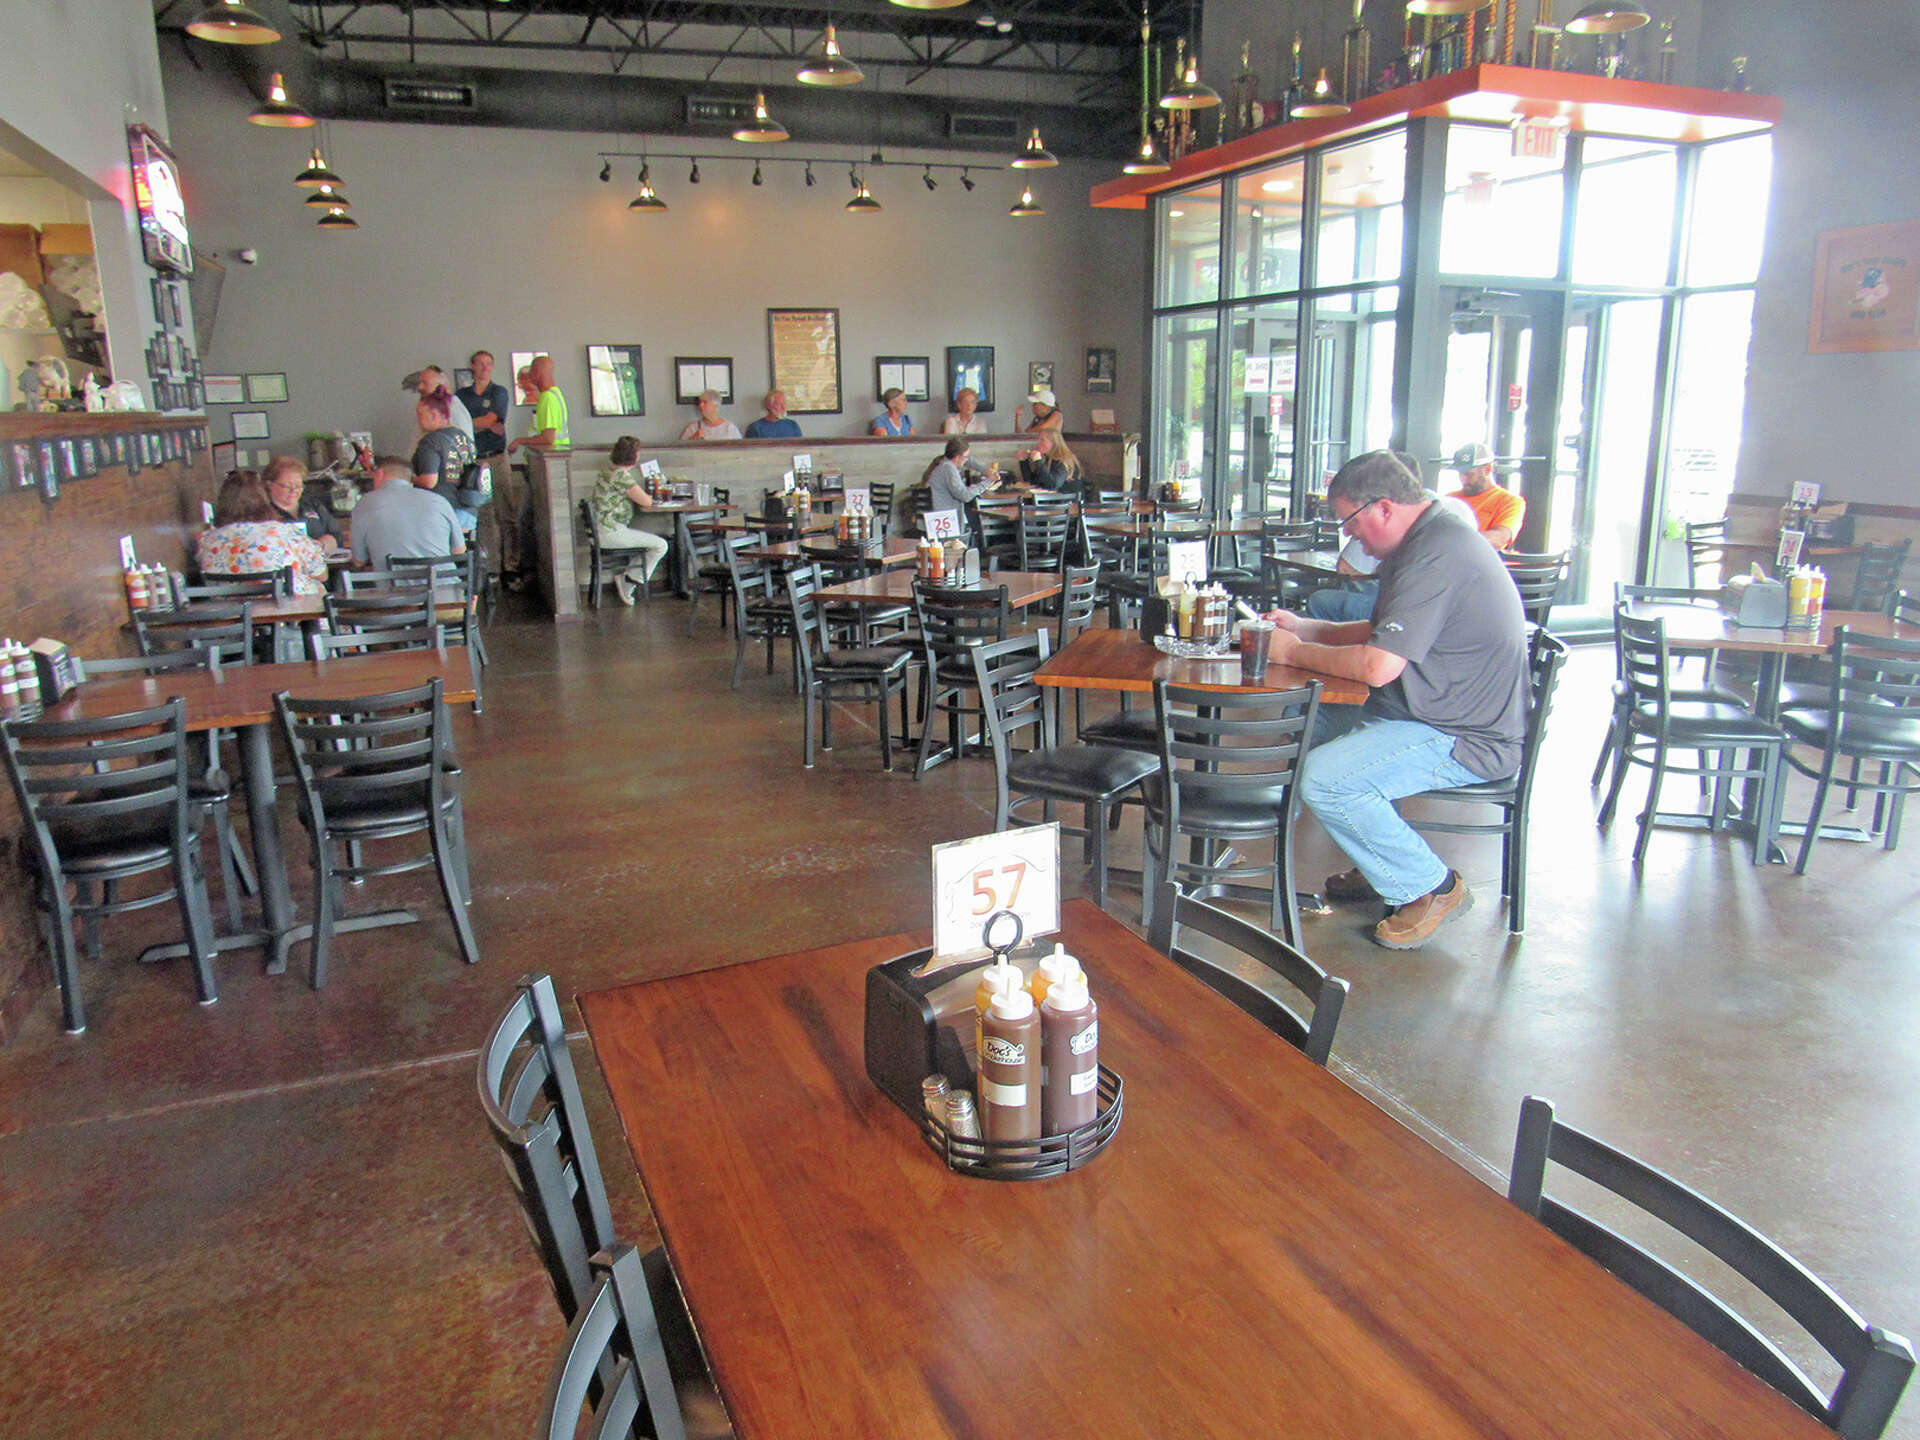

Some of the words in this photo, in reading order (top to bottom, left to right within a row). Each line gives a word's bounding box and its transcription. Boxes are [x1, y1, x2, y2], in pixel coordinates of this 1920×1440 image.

[1524, 125, 1555, 157] EXIT
[852, 494, 864, 504] 27
[934, 517, 951, 531] 26
[972, 862, 1026, 915] 57
[987, 1041, 1012, 1057] Doc's
